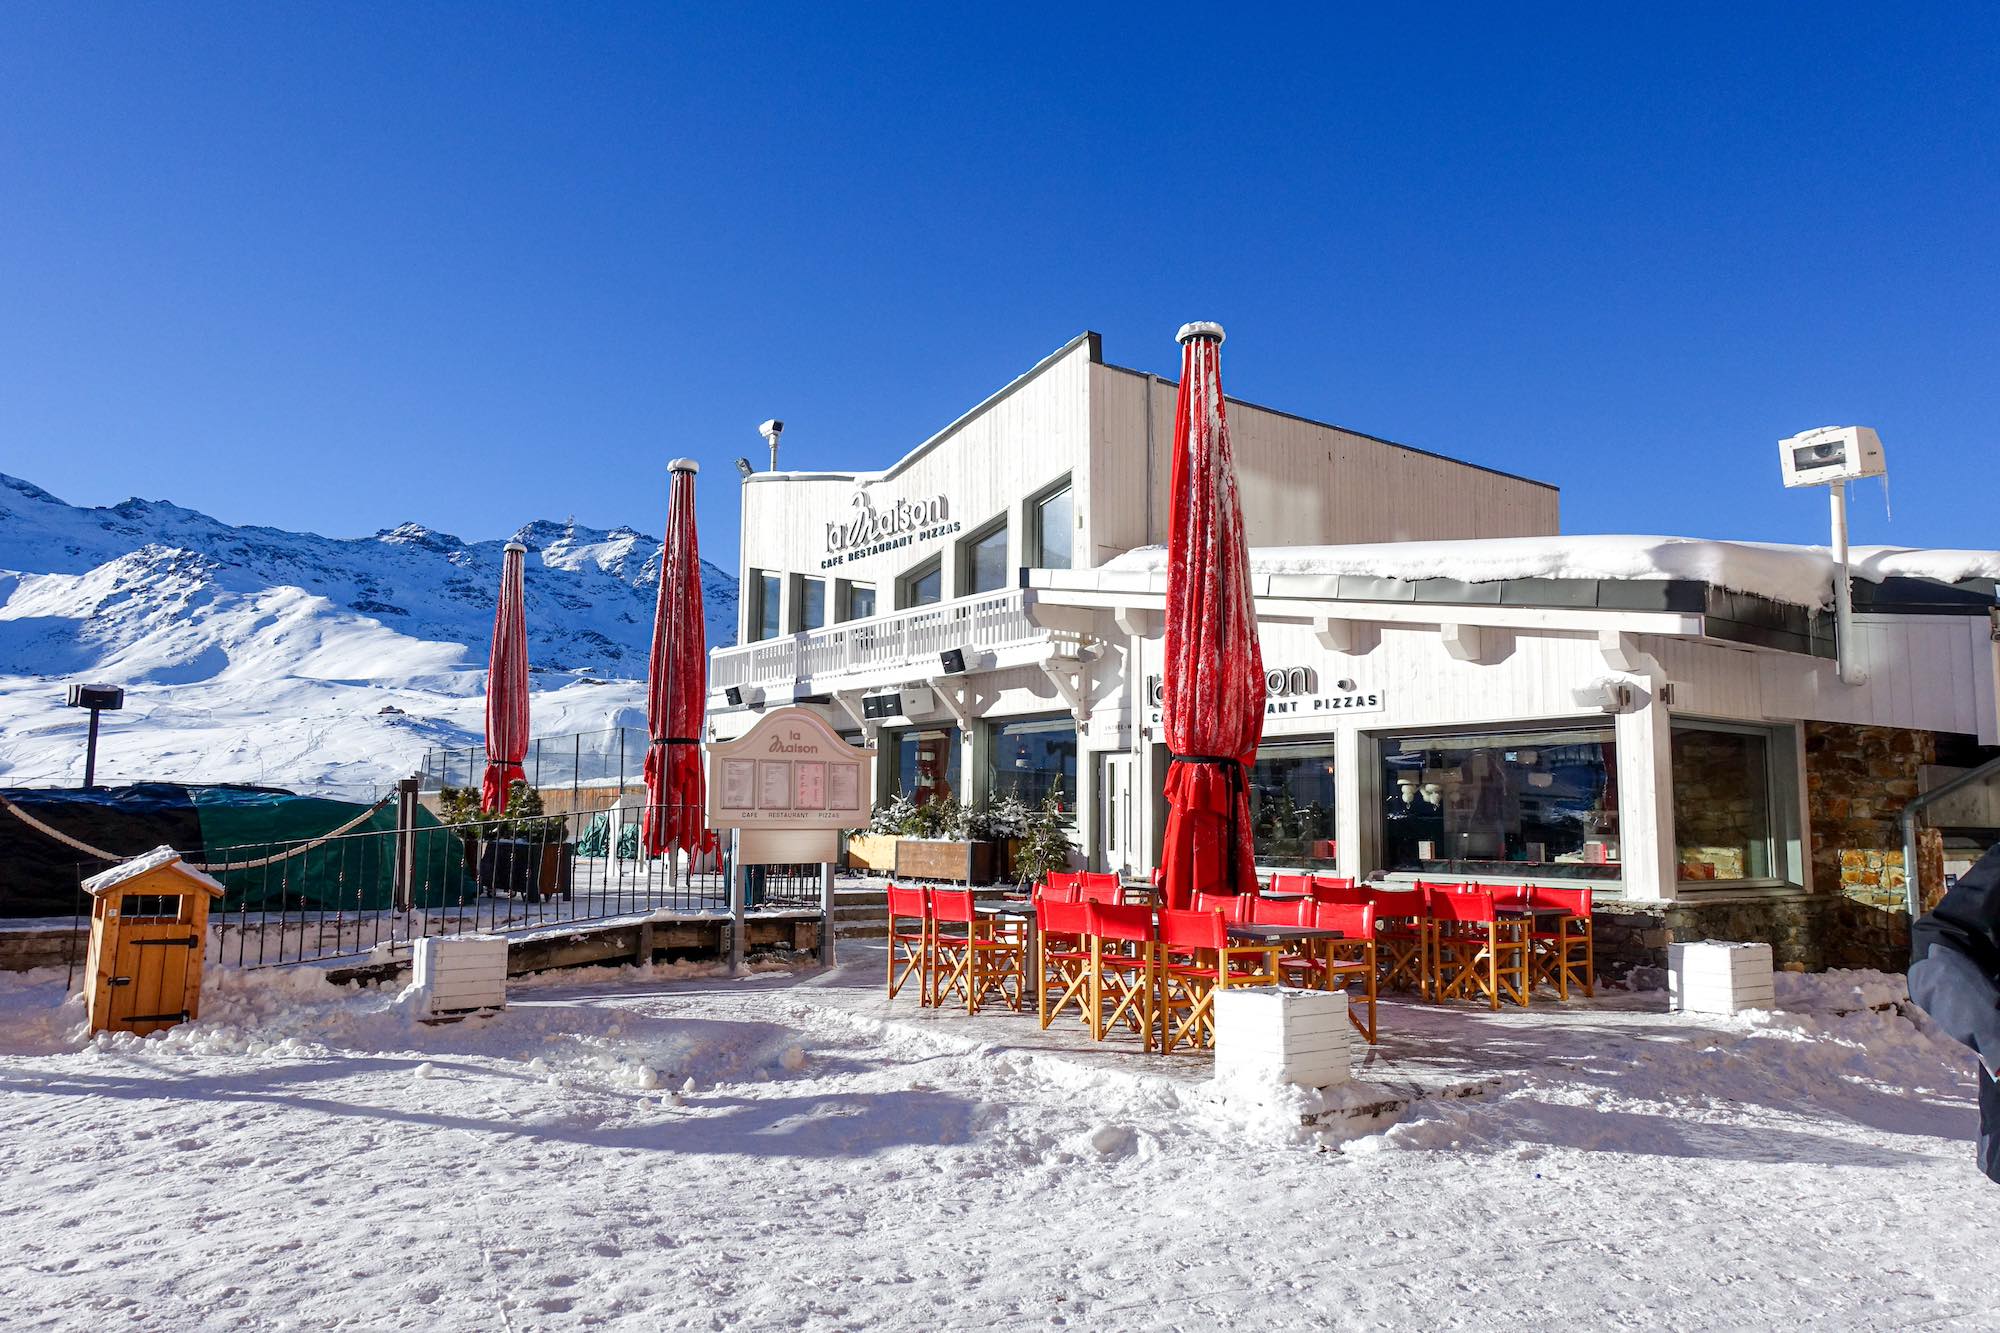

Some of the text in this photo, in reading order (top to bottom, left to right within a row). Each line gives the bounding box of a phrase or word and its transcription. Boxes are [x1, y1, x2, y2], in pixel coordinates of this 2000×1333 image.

[821, 521, 961, 570] CAFE RESTAURANT PIZZAS
[826, 520, 848, 554] la
[1313, 694, 1378, 711] PIZZAS
[768, 734, 818, 754] Maison
[789, 730, 801, 741] la
